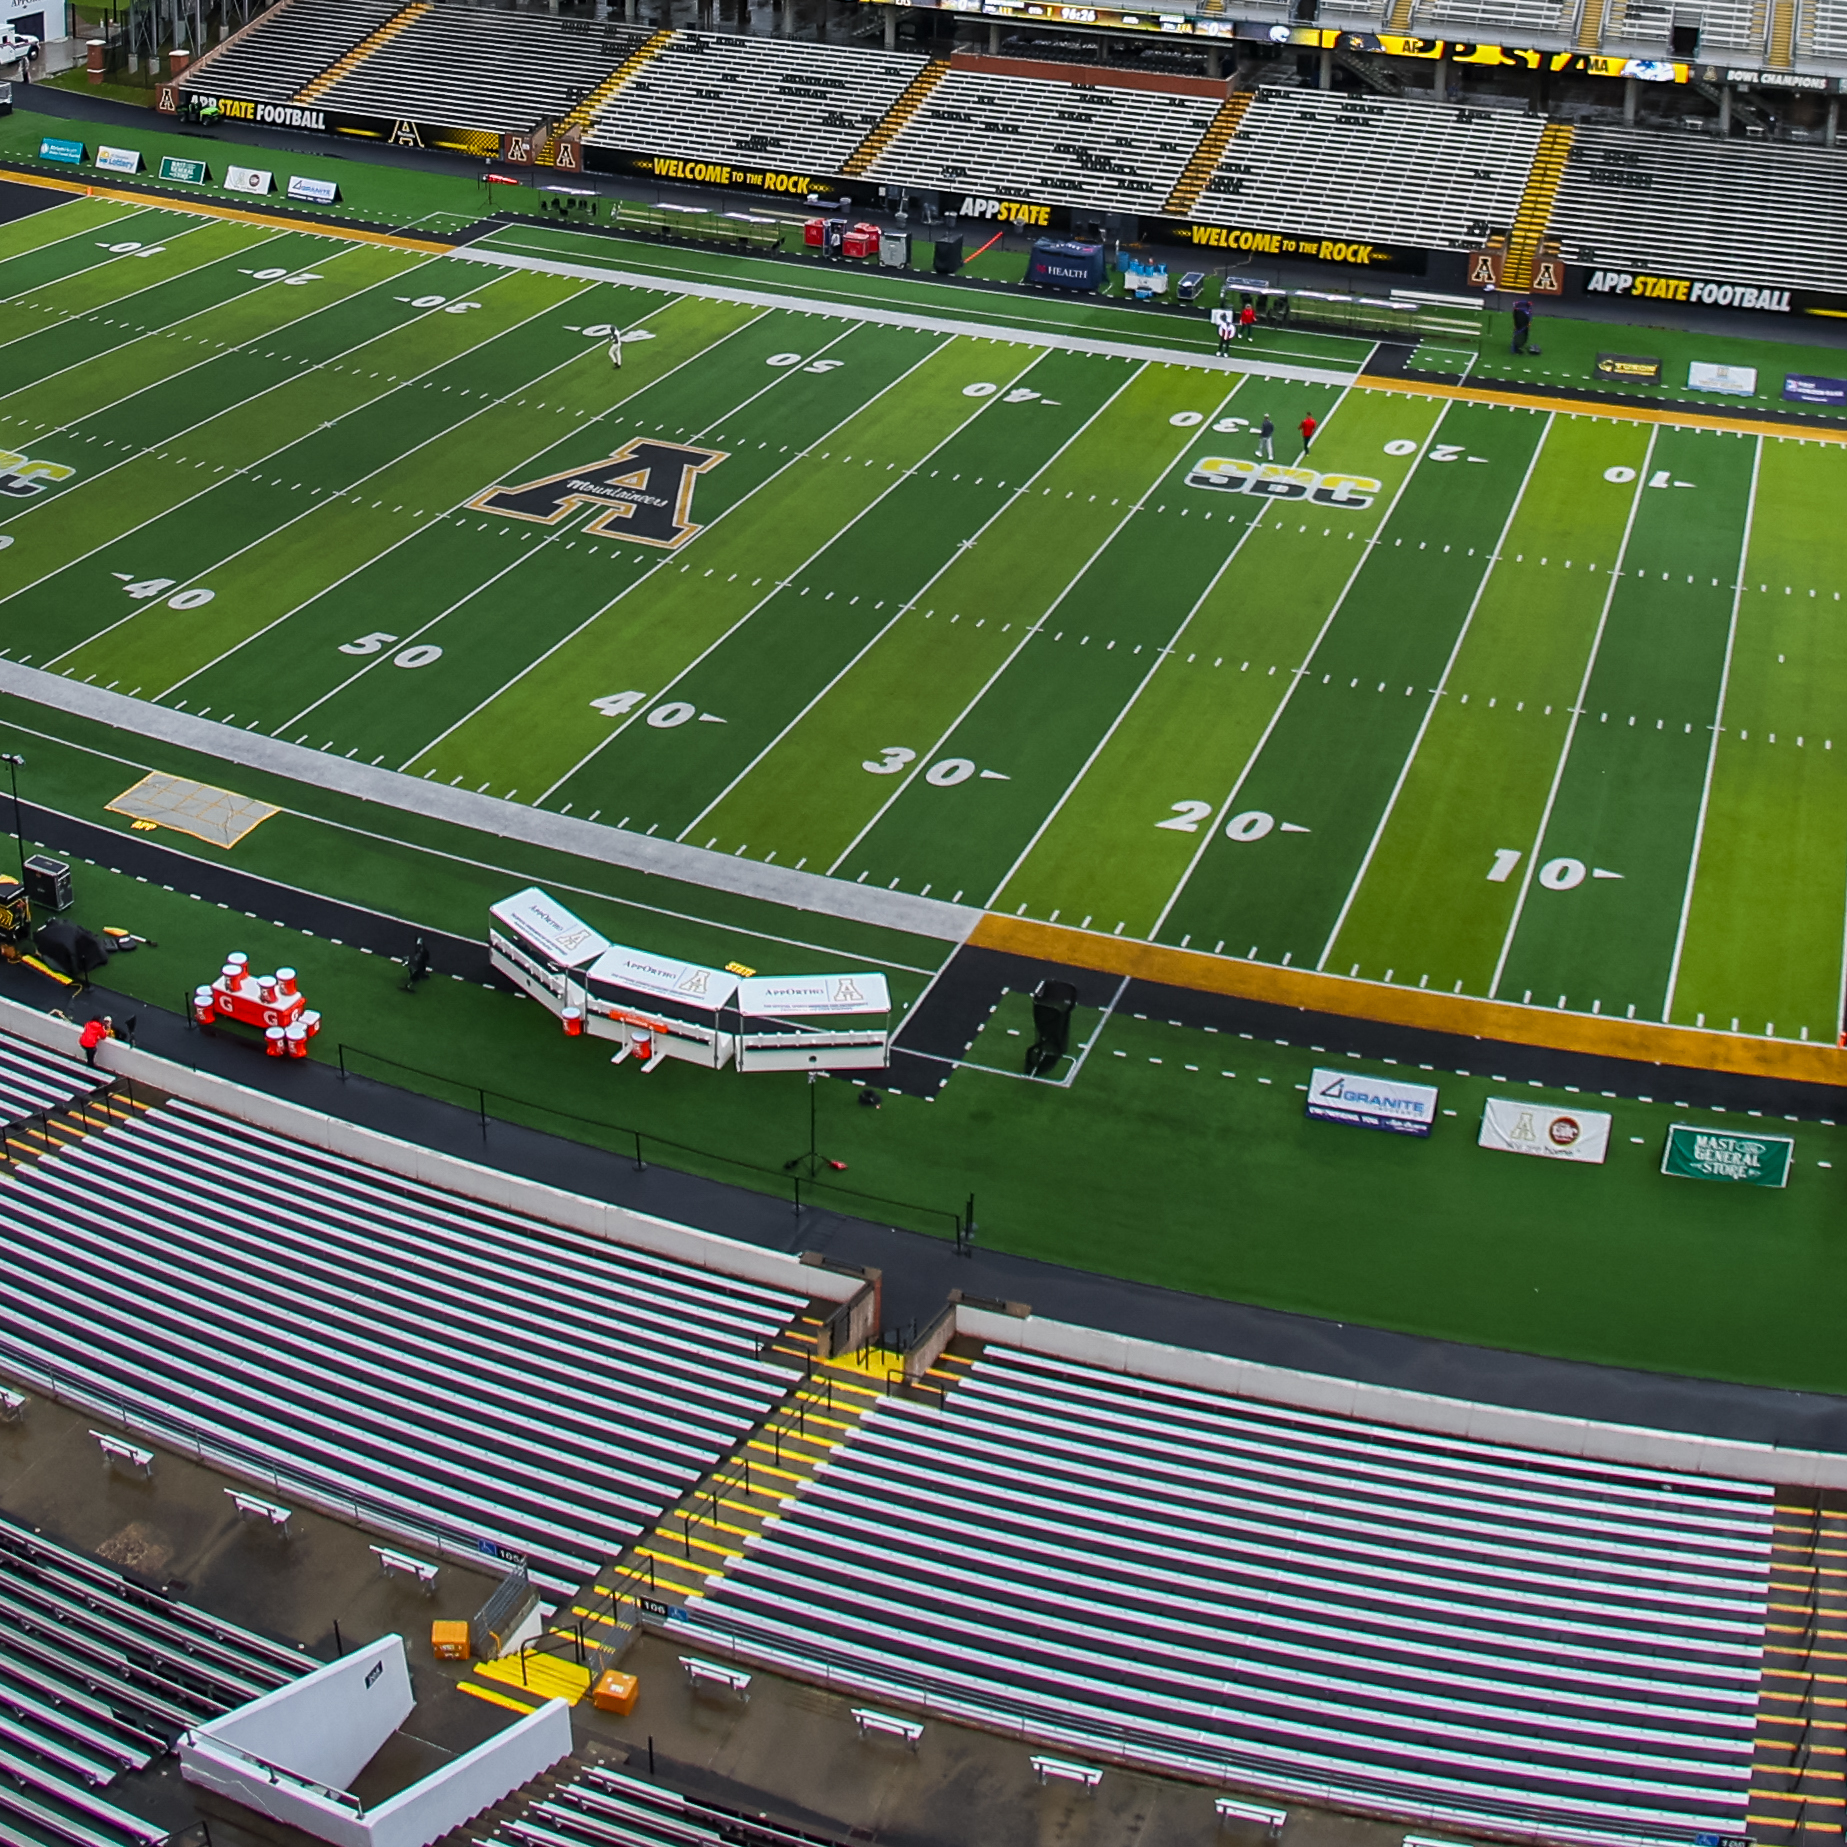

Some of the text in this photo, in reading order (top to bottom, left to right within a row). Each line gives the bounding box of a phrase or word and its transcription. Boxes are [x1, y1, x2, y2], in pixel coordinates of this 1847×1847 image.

[1727, 70, 1828, 90] BOWL CHAMPIONS
[256, 104, 325, 130] FOOTBALL
[654, 158, 810, 195] WELCOME TO THE ROCK
[1192, 225, 1373, 265] WELCOME TO THE ROCK
[1048, 265, 1088, 279] HEALTH
[1689, 281, 1792, 313] FOOTBALL
[567, 478, 670, 508] Mountaineers
[122, 577, 216, 610] 40
[338, 632, 443, 668] 50
[589, 690, 695, 729] 40
[862, 747, 977, 787] 30
[1154, 800, 1276, 842] 20
[1485, 849, 1587, 892] 10
[219, 995, 234, 1012] G
[263, 1000, 279, 1027] G
[1344, 1090, 1426, 1115] GRANITE
[1694, 1145, 1760, 1167] GENERAL
[1695, 1134, 1736, 1153] MAST
[1703, 1162, 1747, 1180] STORE
